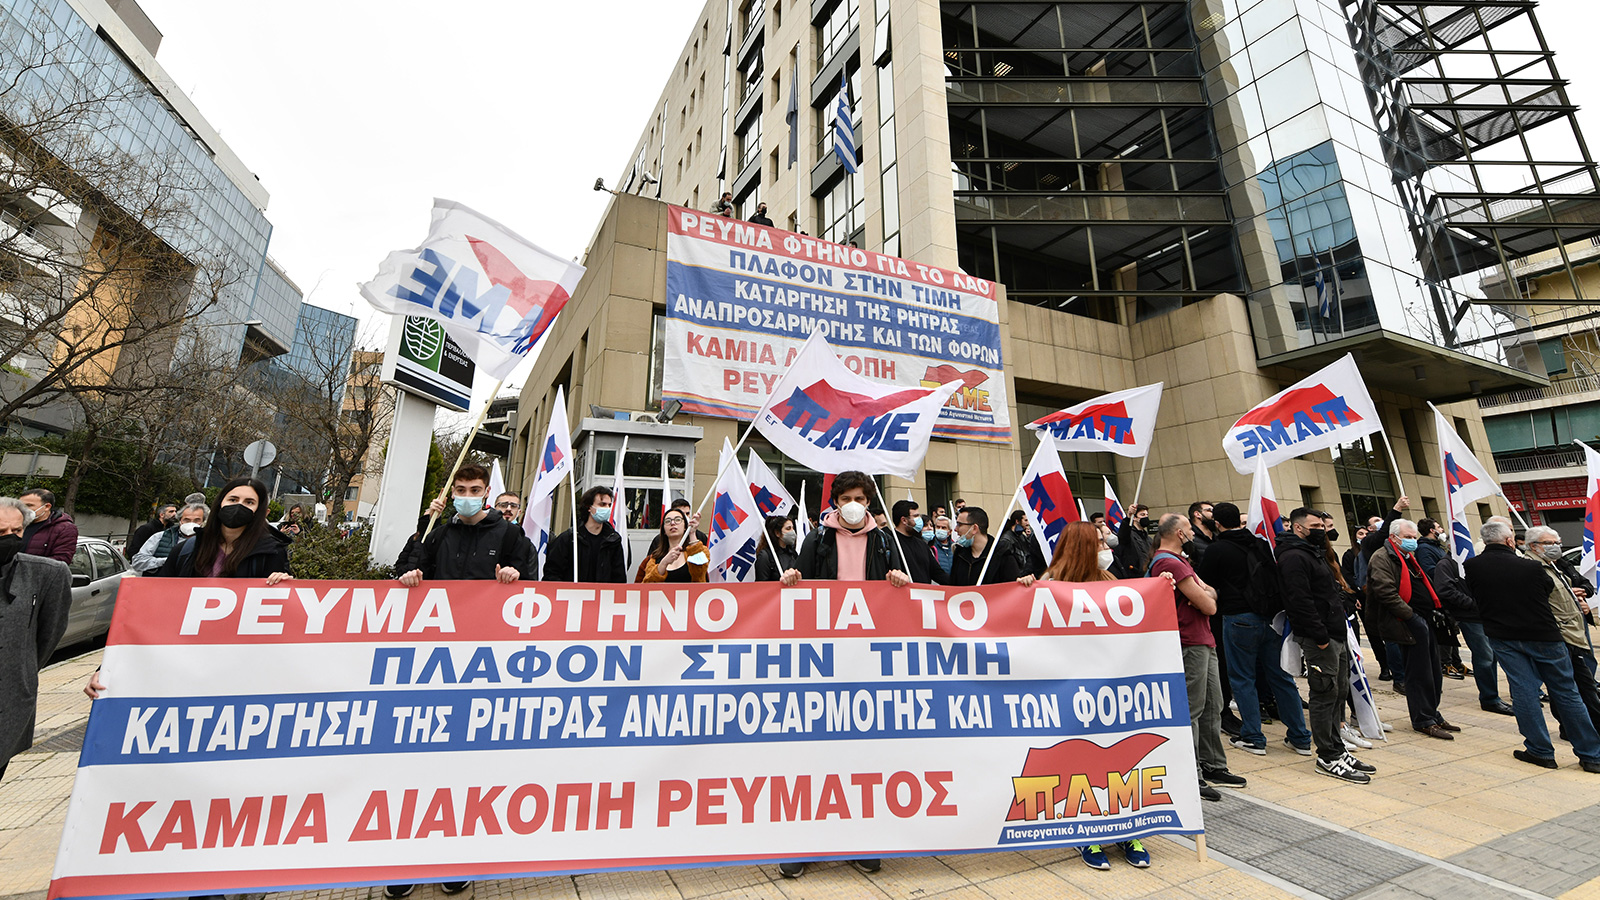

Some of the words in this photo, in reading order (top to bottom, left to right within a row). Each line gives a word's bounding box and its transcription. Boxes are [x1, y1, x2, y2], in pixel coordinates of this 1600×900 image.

[681, 211, 774, 250] ΡΕΥΜΑ
[783, 234, 868, 268] ΦΤΗΝΟ
[876, 254, 911, 278] ΓΙΑ
[916, 264, 944, 284] ΤΟ
[953, 273, 990, 295] ΛΑΟ
[730, 250, 833, 287] ΠΛΑΦΟΝ
[844, 272, 902, 299] ΣΤΗΝ
[912, 285, 962, 311] ΤΙΜΗ
[674, 293, 866, 342] ΑΝΑΠΡΟΣΑΡΜΟΓΗΣ
[873, 326, 901, 347] ΚΑΙ
[908, 332, 942, 354] ΤΩΝ
[948, 339, 999, 364] ΦΟΡΩΝ
[735, 280, 848, 317] ΚΑΤΑΡΓΗΣΗ
[855, 300, 891, 323] ΤΗΣ
[897, 307, 960, 335] ΡΗΤΡΑΣ
[686, 331, 776, 366] ΚΑΜΙΑ
[1536, 500, 1569, 508] ΑΝΔΡΙΚΑ
[179, 587, 456, 635] ΡΕΥΜΑ
[501, 587, 739, 634] ΦΤΗΝΟ
[780, 588, 875, 631] ΓΙΑ
[910, 588, 989, 631] ΤΟ
[1027, 586, 1145, 629] ΛΑΟ
[369, 645, 643, 685] ΠΛΑΦΟΝ
[680, 643, 834, 680] ΣΤΗΝ
[870, 642, 1011, 676] ΤΙΜΗ
[120, 700, 377, 754] ΚΑΤΑΡΓΗΣΗ
[392, 706, 452, 744] ΤΗΣ
[466, 695, 608, 742] ΡΗΤΡΑΣ
[619, 689, 936, 738] ΑΝΑΠΡΟΣΑΡΜΟΓΗΣ
[948, 695, 993, 729] ΚΑΙ
[1003, 694, 1061, 728] ΤΩΝ
[1072, 681, 1172, 727] ΦΟΡΩΝ
[98, 792, 328, 854] ΚΑΜΙΑ
[347, 781, 635, 842] ΔΙΑΚΟΠΗ
[657, 771, 958, 828] ΡΕΥΜΑΤΟΣ
[1006, 824, 1074, 840] Πανεργατικό
[1077, 821, 1133, 836] Αγωνιστικό
[1134, 815, 1173, 828] Μέτωπο
